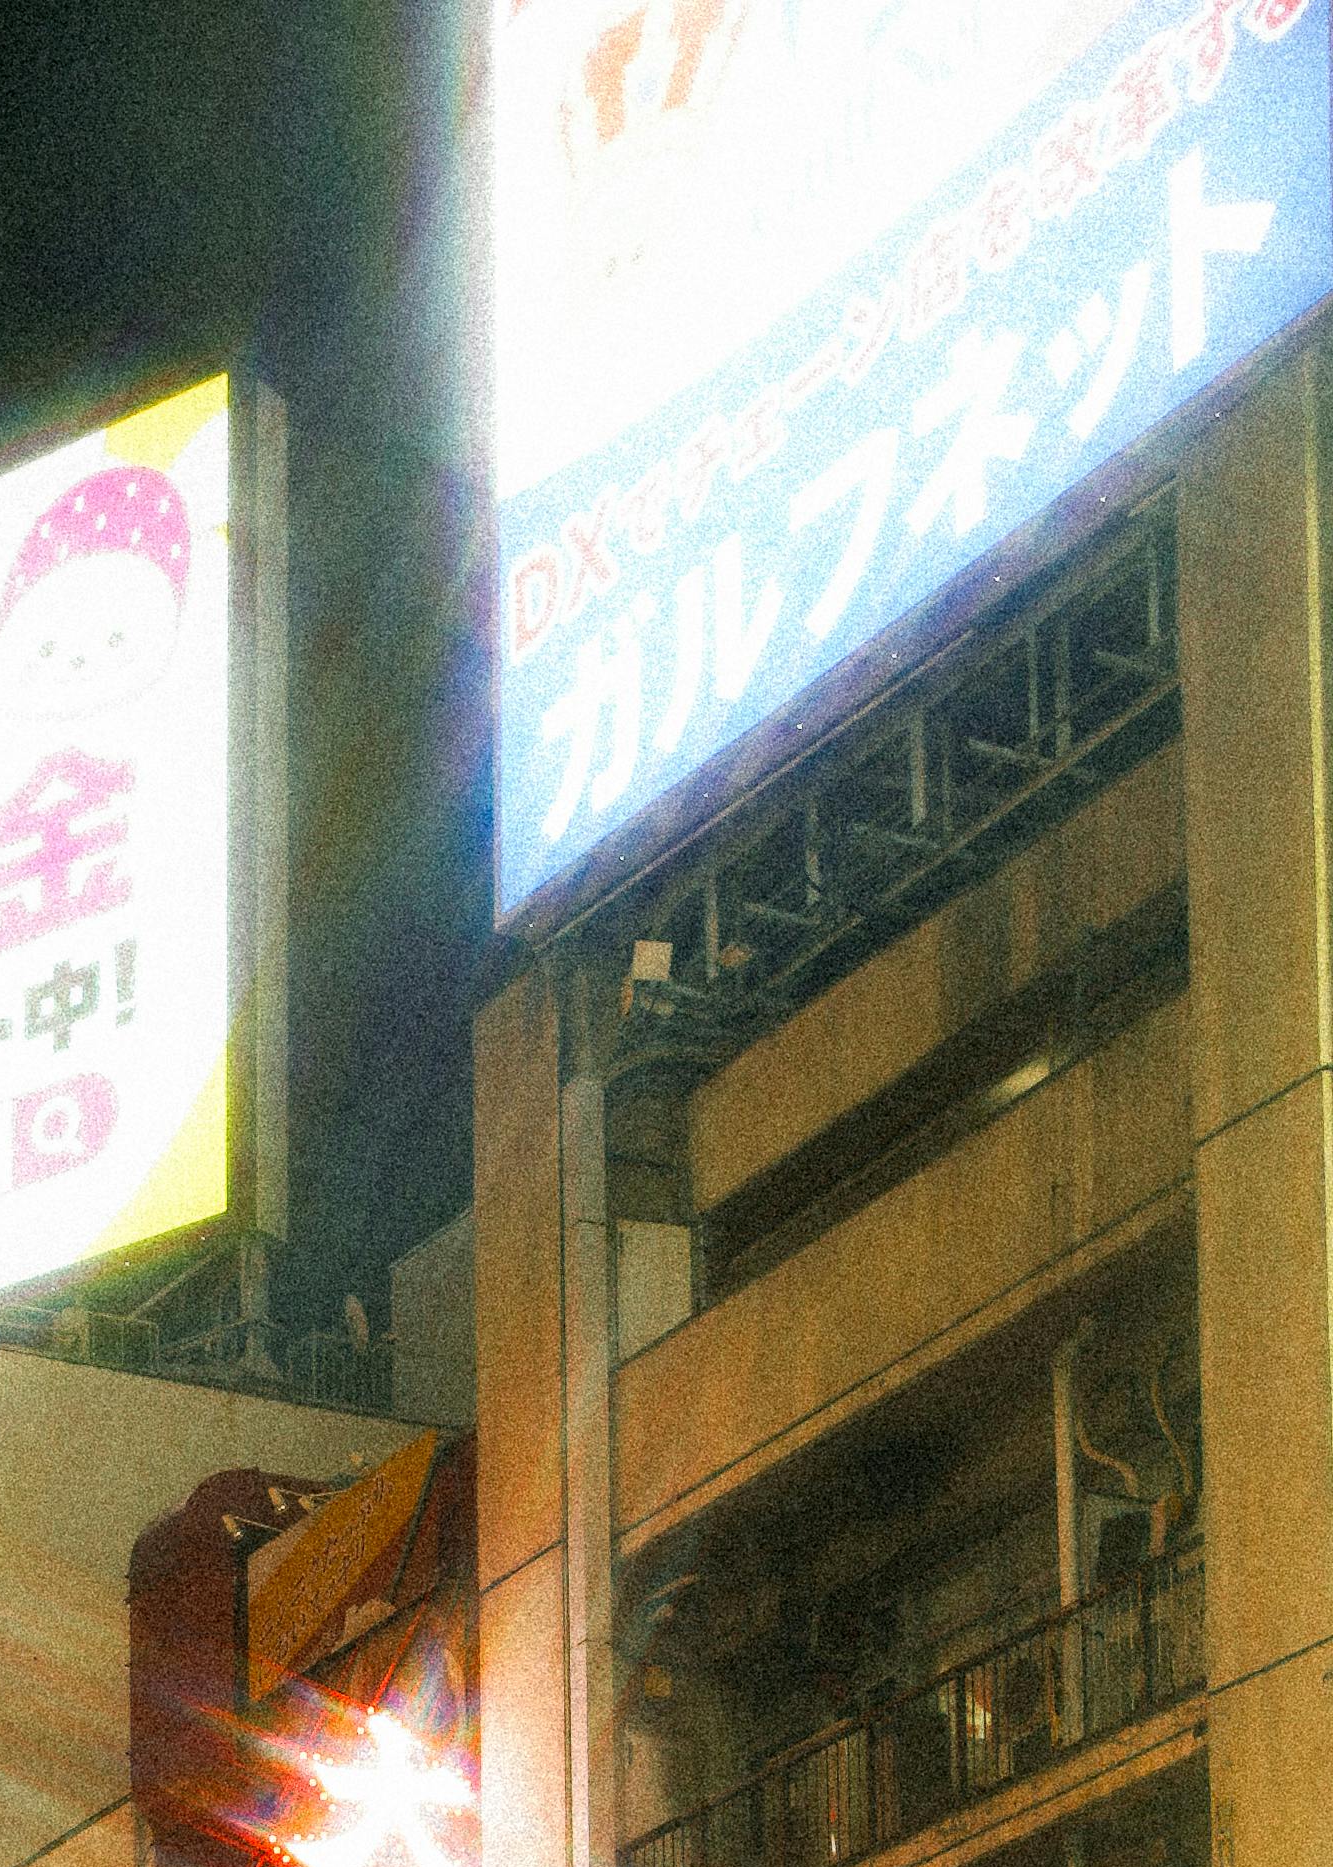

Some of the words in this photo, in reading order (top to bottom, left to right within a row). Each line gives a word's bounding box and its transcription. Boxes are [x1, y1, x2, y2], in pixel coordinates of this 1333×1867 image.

[542, 143, 1275, 842] ガルフネット
